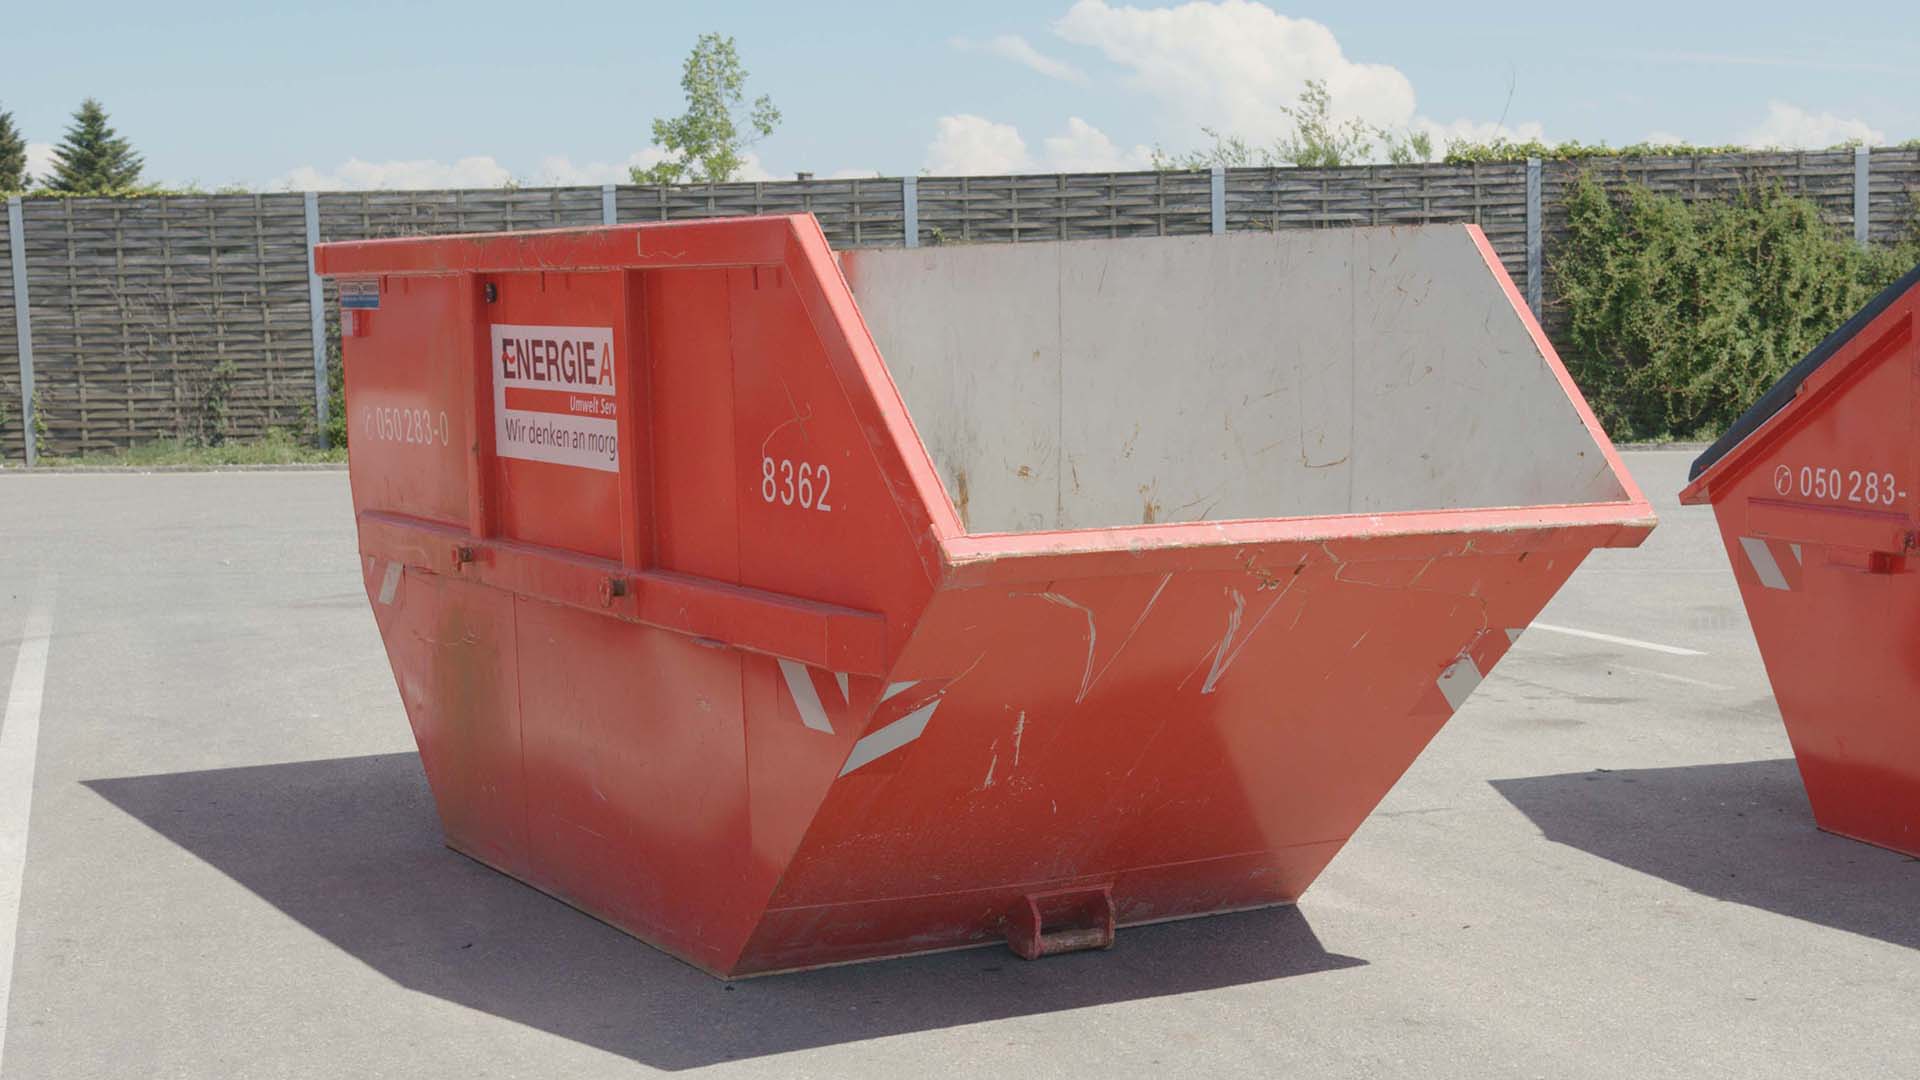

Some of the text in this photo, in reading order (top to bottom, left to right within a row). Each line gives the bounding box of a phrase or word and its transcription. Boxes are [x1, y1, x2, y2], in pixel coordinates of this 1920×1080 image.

[570, 395, 598, 414] Umwelt
[376, 407, 449, 447] 050 283-0
[505, 418, 526, 443] Wir
[528, 420, 569, 448] denken
[572, 431, 585, 451] an
[762, 457, 831, 511] 8362
[1800, 466, 1906, 505] 050 283-
